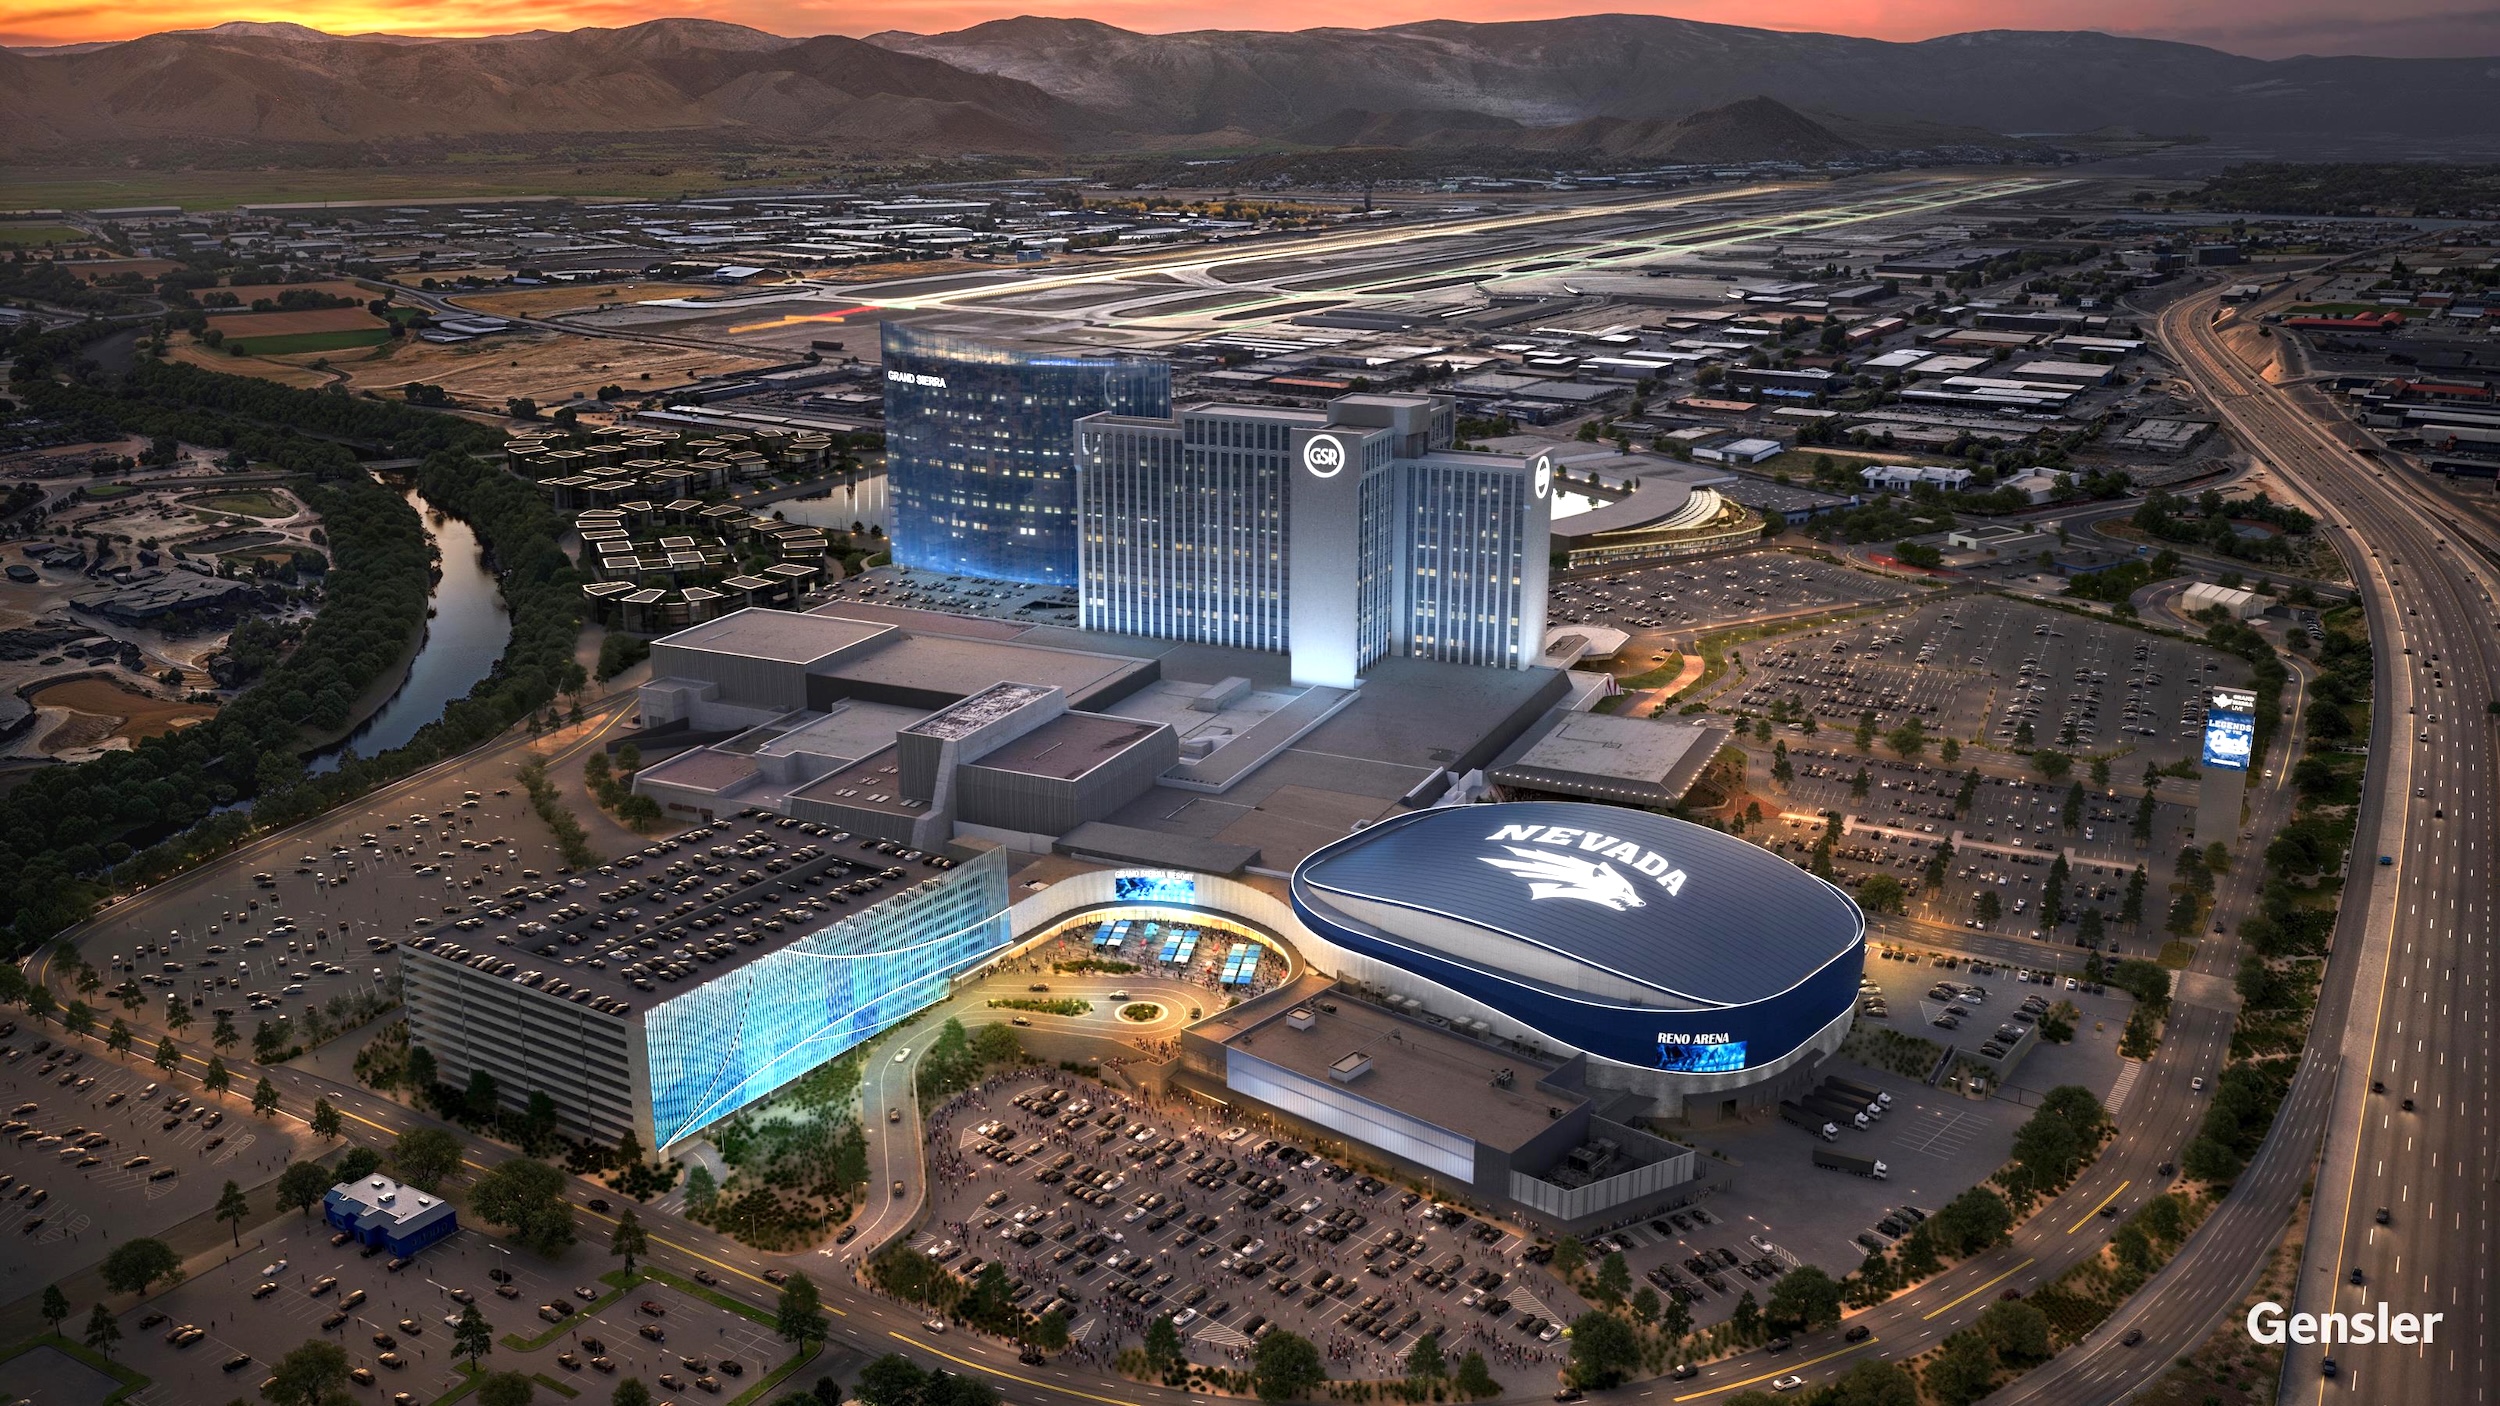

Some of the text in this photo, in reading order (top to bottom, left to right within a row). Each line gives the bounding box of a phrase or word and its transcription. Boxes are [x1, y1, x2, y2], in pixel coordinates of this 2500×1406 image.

[887, 370, 947, 388] GRAND SIERRA
[1310, 447, 1338, 466] GSR
[2208, 719, 2252, 732] LEGENDS
[1484, 824, 1688, 897] NEVADA
[1115, 870, 1139, 878] GRAND
[1657, 1032, 1730, 1045] RENO ARENA
